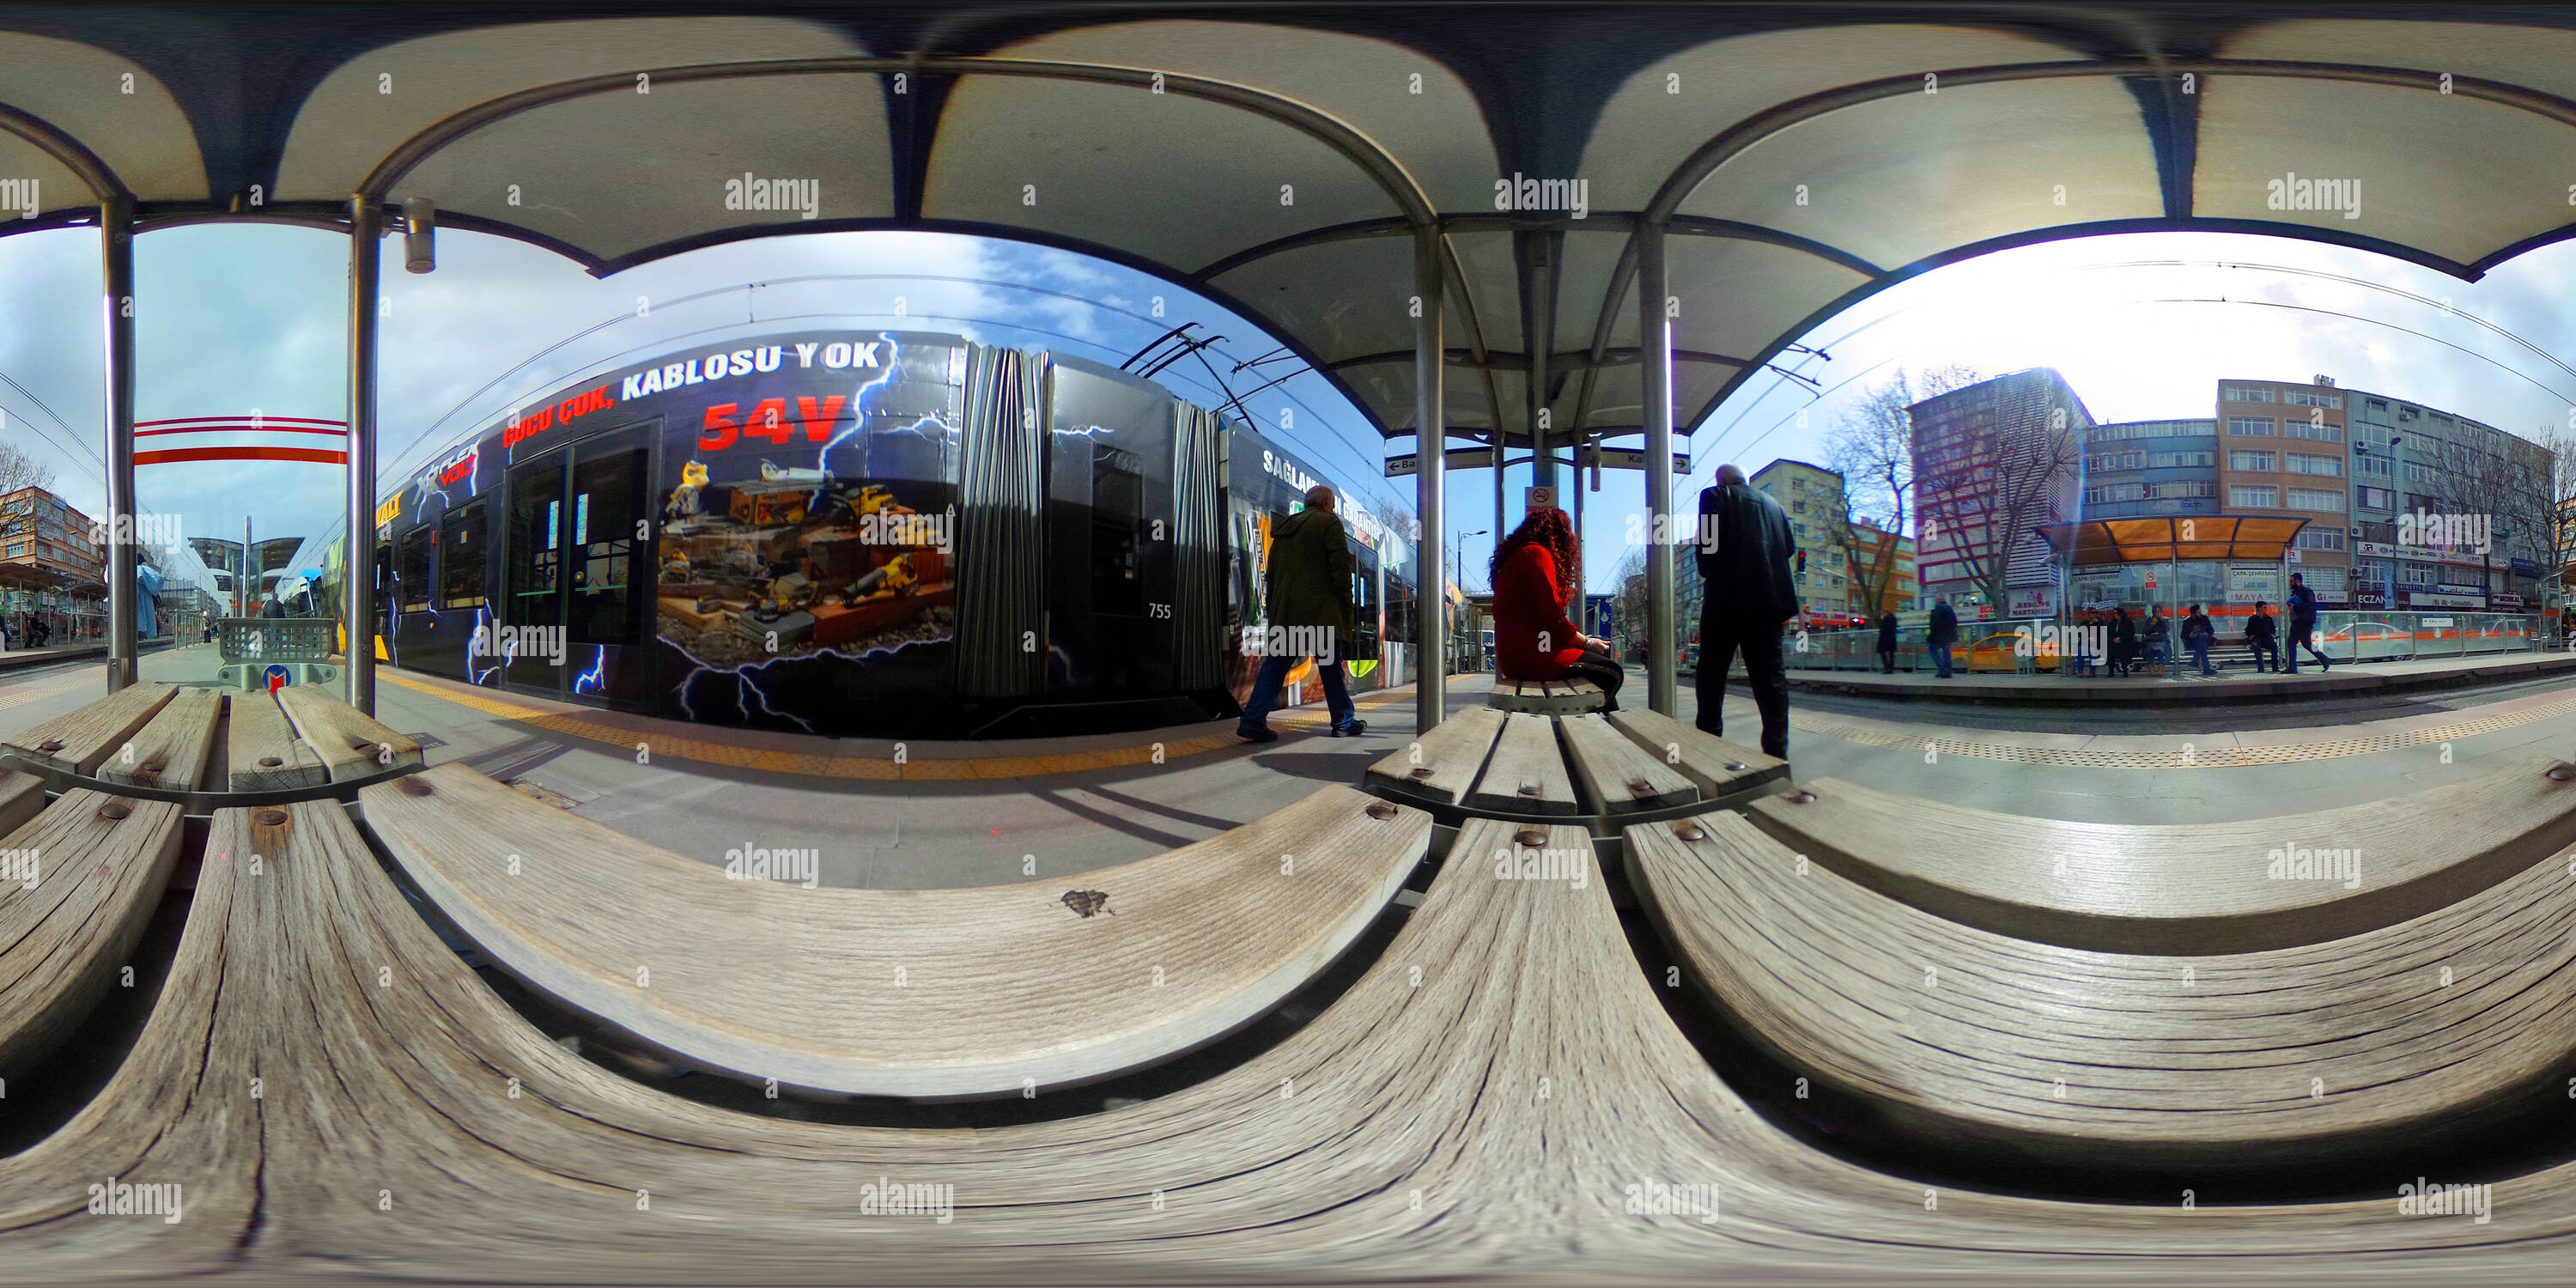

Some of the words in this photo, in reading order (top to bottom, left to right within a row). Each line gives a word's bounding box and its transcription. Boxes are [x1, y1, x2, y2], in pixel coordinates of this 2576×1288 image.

[559, 385, 615, 425] ÇOK,
[621, 345, 782, 401] KABLOSU
[795, 342, 881, 369] YOK
[698, 395, 847, 452] 54V
[1628, 454, 1643, 463] Ka
[945, 503, 956, 517] A
[2358, 594, 2385, 604] ECZAN
[1149, 603, 1171, 619] 755
